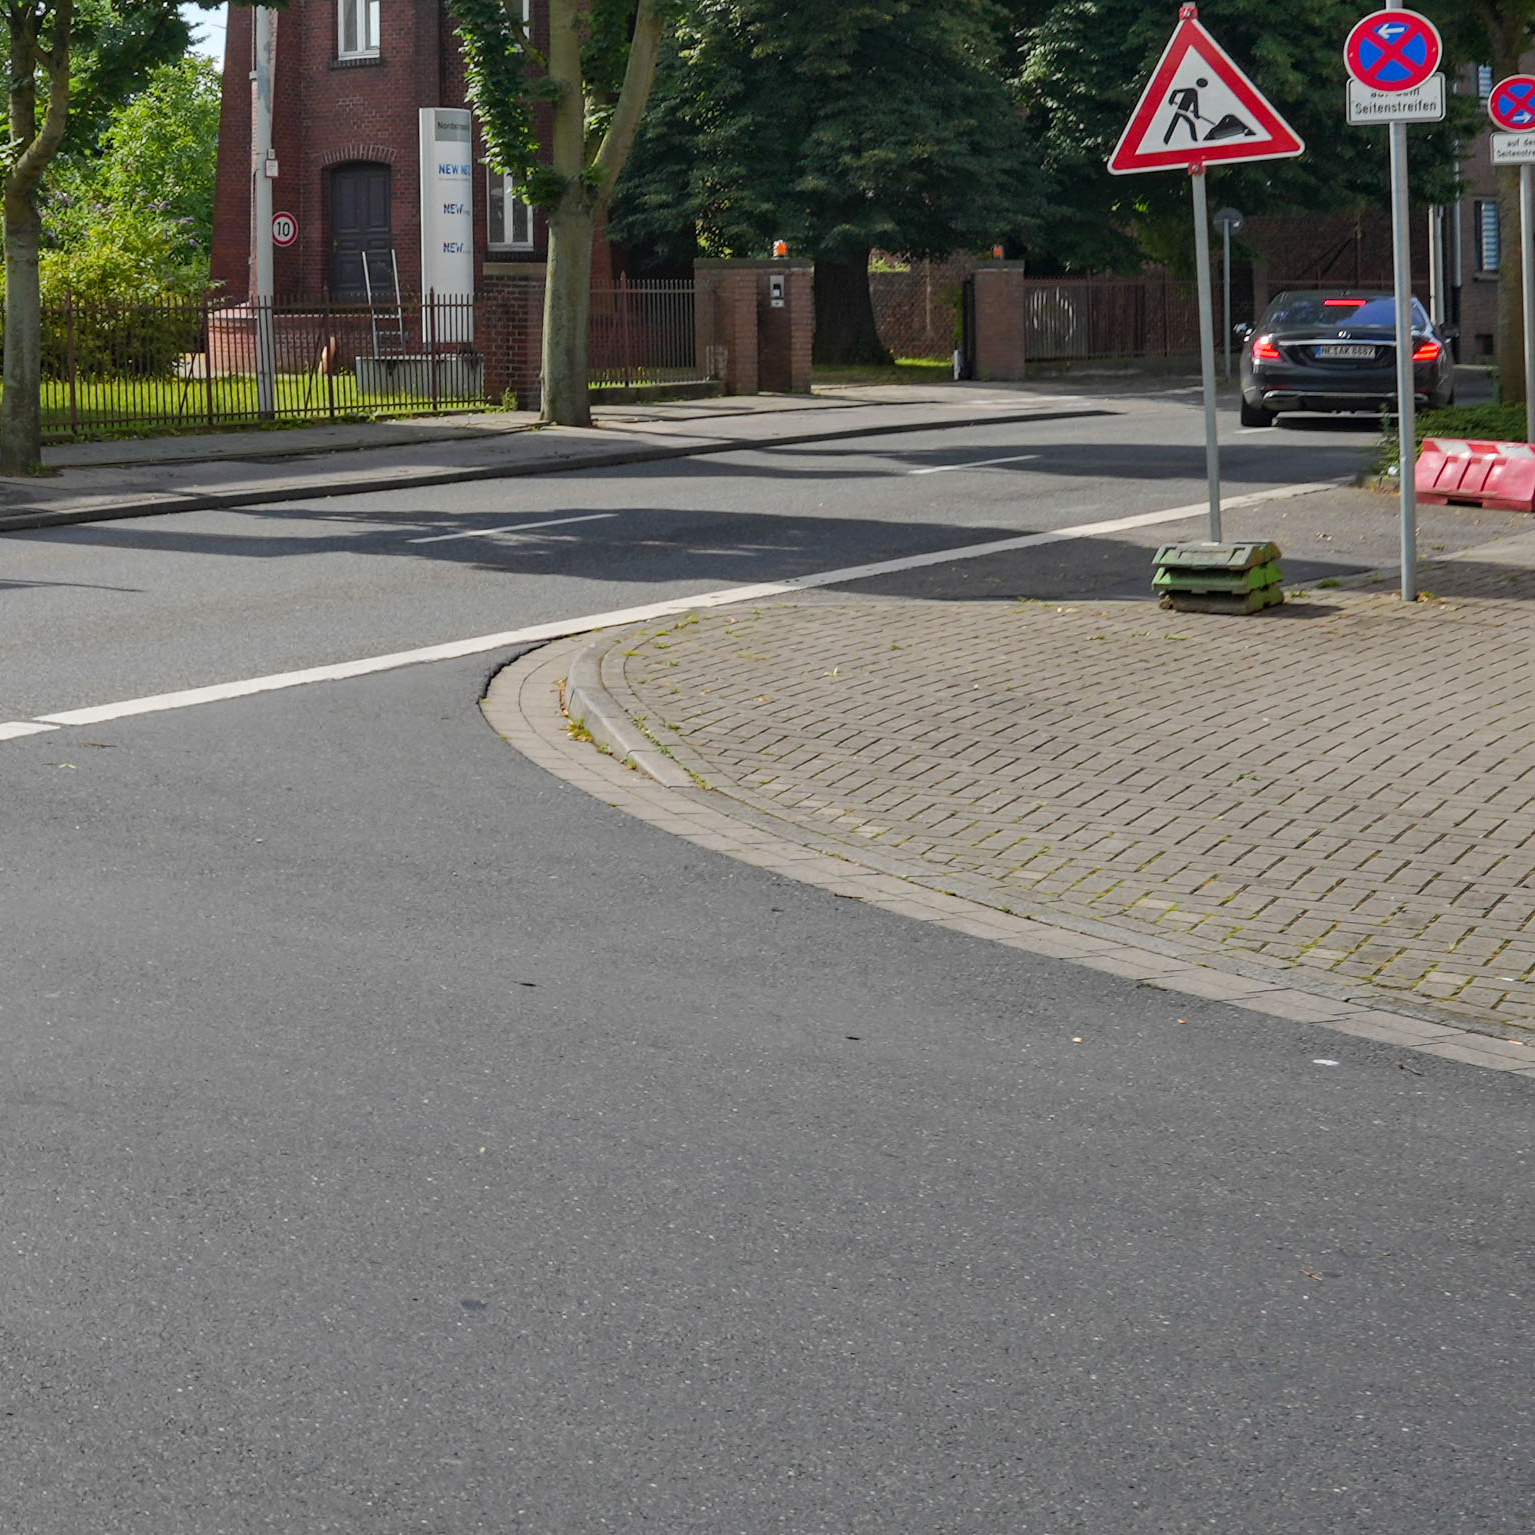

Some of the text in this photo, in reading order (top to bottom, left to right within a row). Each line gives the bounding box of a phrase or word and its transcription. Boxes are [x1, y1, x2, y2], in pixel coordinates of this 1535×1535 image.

[1355, 99, 1437, 114] Seitenstreifen
[438, 163, 459, 175] NEW
[277, 222, 290, 237] 10
